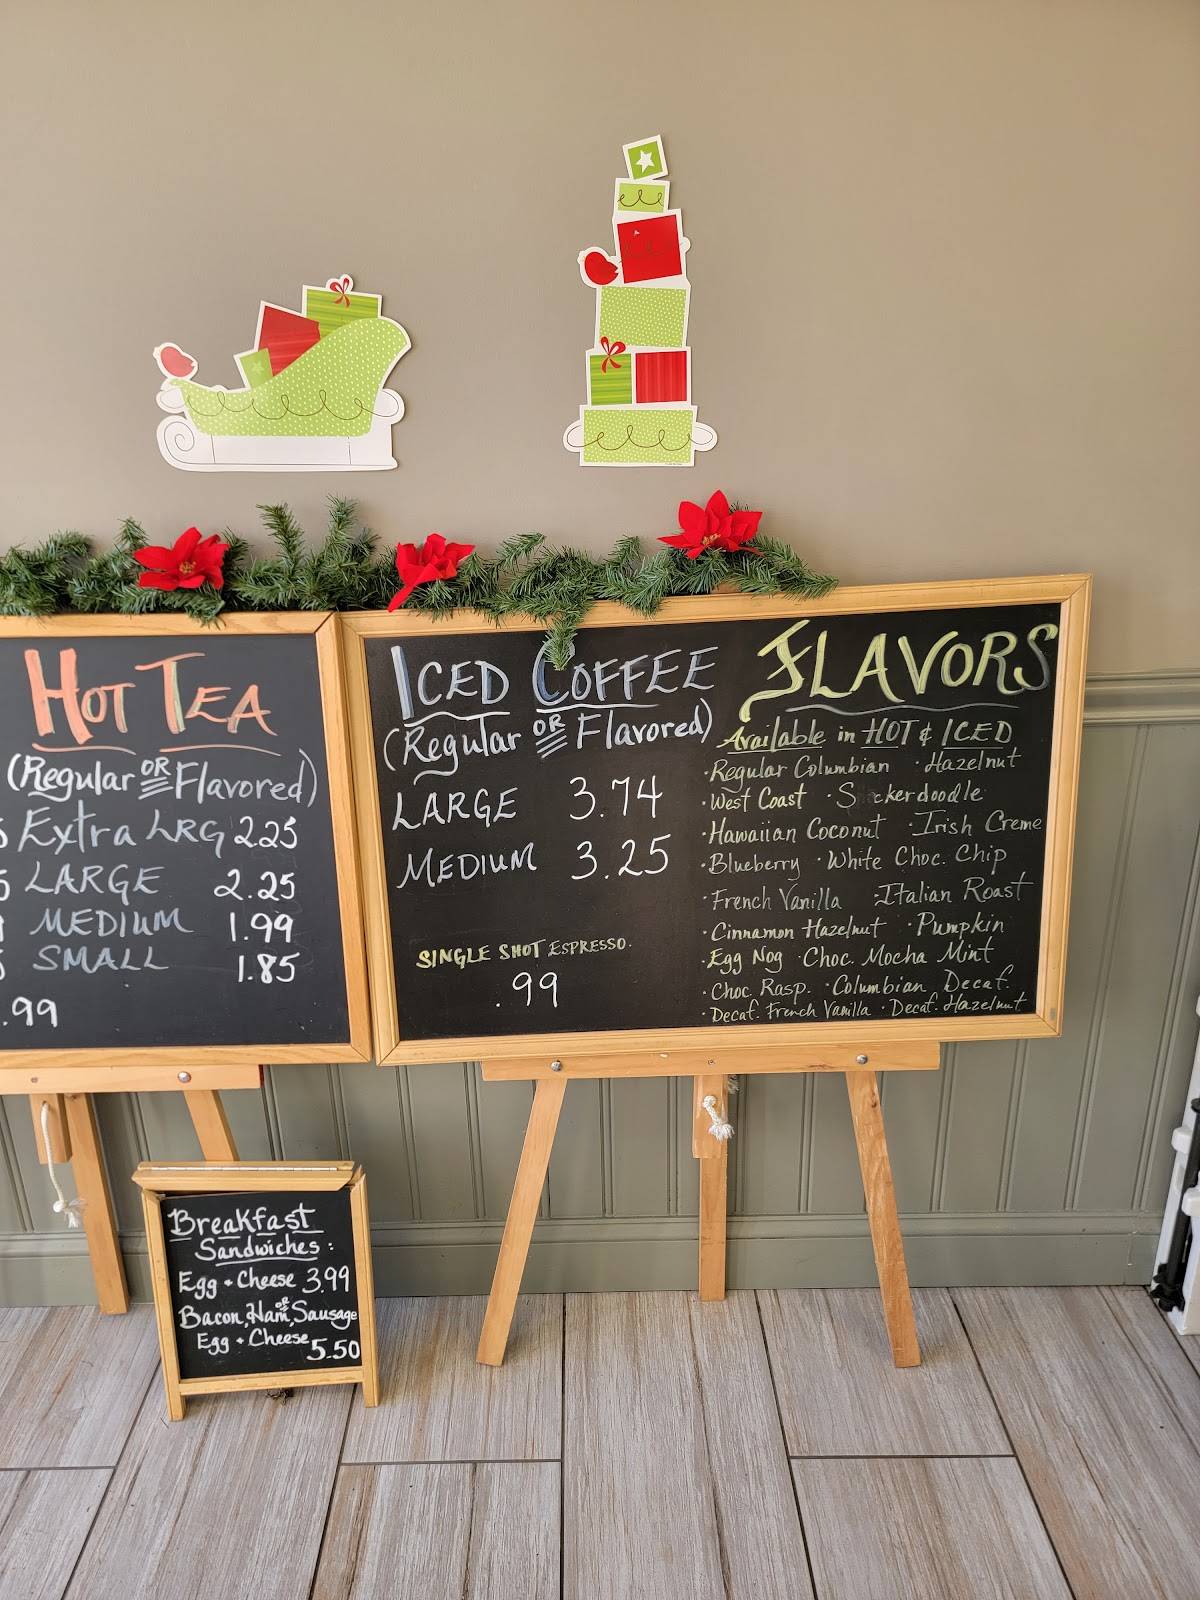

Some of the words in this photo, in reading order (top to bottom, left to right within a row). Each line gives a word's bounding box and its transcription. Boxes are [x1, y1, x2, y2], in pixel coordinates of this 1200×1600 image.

[391, 645, 509, 720] ICED
[532, 636, 719, 707] COFFEE
[739, 619, 1059, 723] FLAVORS
[24, 648, 136, 744] HOT
[135, 652, 278, 736] TEA
[383, 715, 521, 785] (Regular
[577, 698, 713, 751] Flavored)
[716, 716, 827, 753] Available
[838, 725, 856, 744] in
[862, 718, 919, 746] HOT
[942, 719, 1013, 747] ICED
[7, 753, 135, 801] (Regular
[175, 748, 318, 807] Flavored)
[709, 757, 788, 794] Regular
[794, 755, 890, 780] Columbian
[925, 746, 1022, 773] Hazelnut
[392, 787, 518, 831] LARGE
[568, 775, 663, 820] 3.74
[710, 791, 751, 812] West
[758, 783, 807, 810] Coast
[18, 800, 137, 855] Extra
[145, 808, 226, 858] LRG
[233, 816, 298, 849] 2.25
[708, 817, 797, 846] Hawaiian
[806, 814, 887, 841] Coconut
[912, 810, 972, 838] Irish
[985, 810, 1043, 834] Creme
[396, 842, 537, 889] MEDIUM
[571, 834, 671, 881] 3.25
[709, 852, 801, 881] Blueberry
[827, 848, 882, 872] White
[895, 846, 946, 867] Choc.
[956, 844, 1008, 875] Chip
[25, 861, 165, 905] LARGE
[213, 869, 296, 901] 2.25
[712, 887, 771, 911] French
[779, 884, 842, 911] Vanilla
[874, 882, 952, 907] Italian
[963, 872, 1034, 902] Roast
[29, 907, 194, 937] MEDIUM
[229, 912, 294, 943] 1.99
[711, 921, 795, 942] Cinnamon
[802, 915, 887, 940] Hazelnut
[917, 911, 1004, 942] Pumpkin
[33, 945, 169, 973] SMALL
[238, 952, 300, 983] 1.85
[416, 945, 491, 969] SINGLE
[499, 939, 546, 960] SHOT
[707, 948, 743, 975] Egg
[752, 945, 784, 974] Nog
[803, 946, 855, 968] Choc.
[862, 944, 928, 967] Mocha
[937, 936, 995, 964] Mint
[760, 978, 811, 1005] Rasp.
[833, 973, 928, 997] Columbian
[767, 1001, 817, 1020] French
[824, 999, 872, 1019] Vanilla
[940, 991, 1027, 1012] Hazelnut
[168, 1203, 316, 1238] Breakfast
[178, 1271, 218, 1300] Egg
[236, 1267, 297, 1290] Cheese
[302, 1265, 350, 1294] 3.99
[178, 1305, 249, 1329] Bacon,
[291, 1300, 358, 1330] Sausage
[197, 1333, 230, 1356] Egg
[248, 1328, 310, 1347] Cheese
[306, 1338, 361, 1361] 5.50
